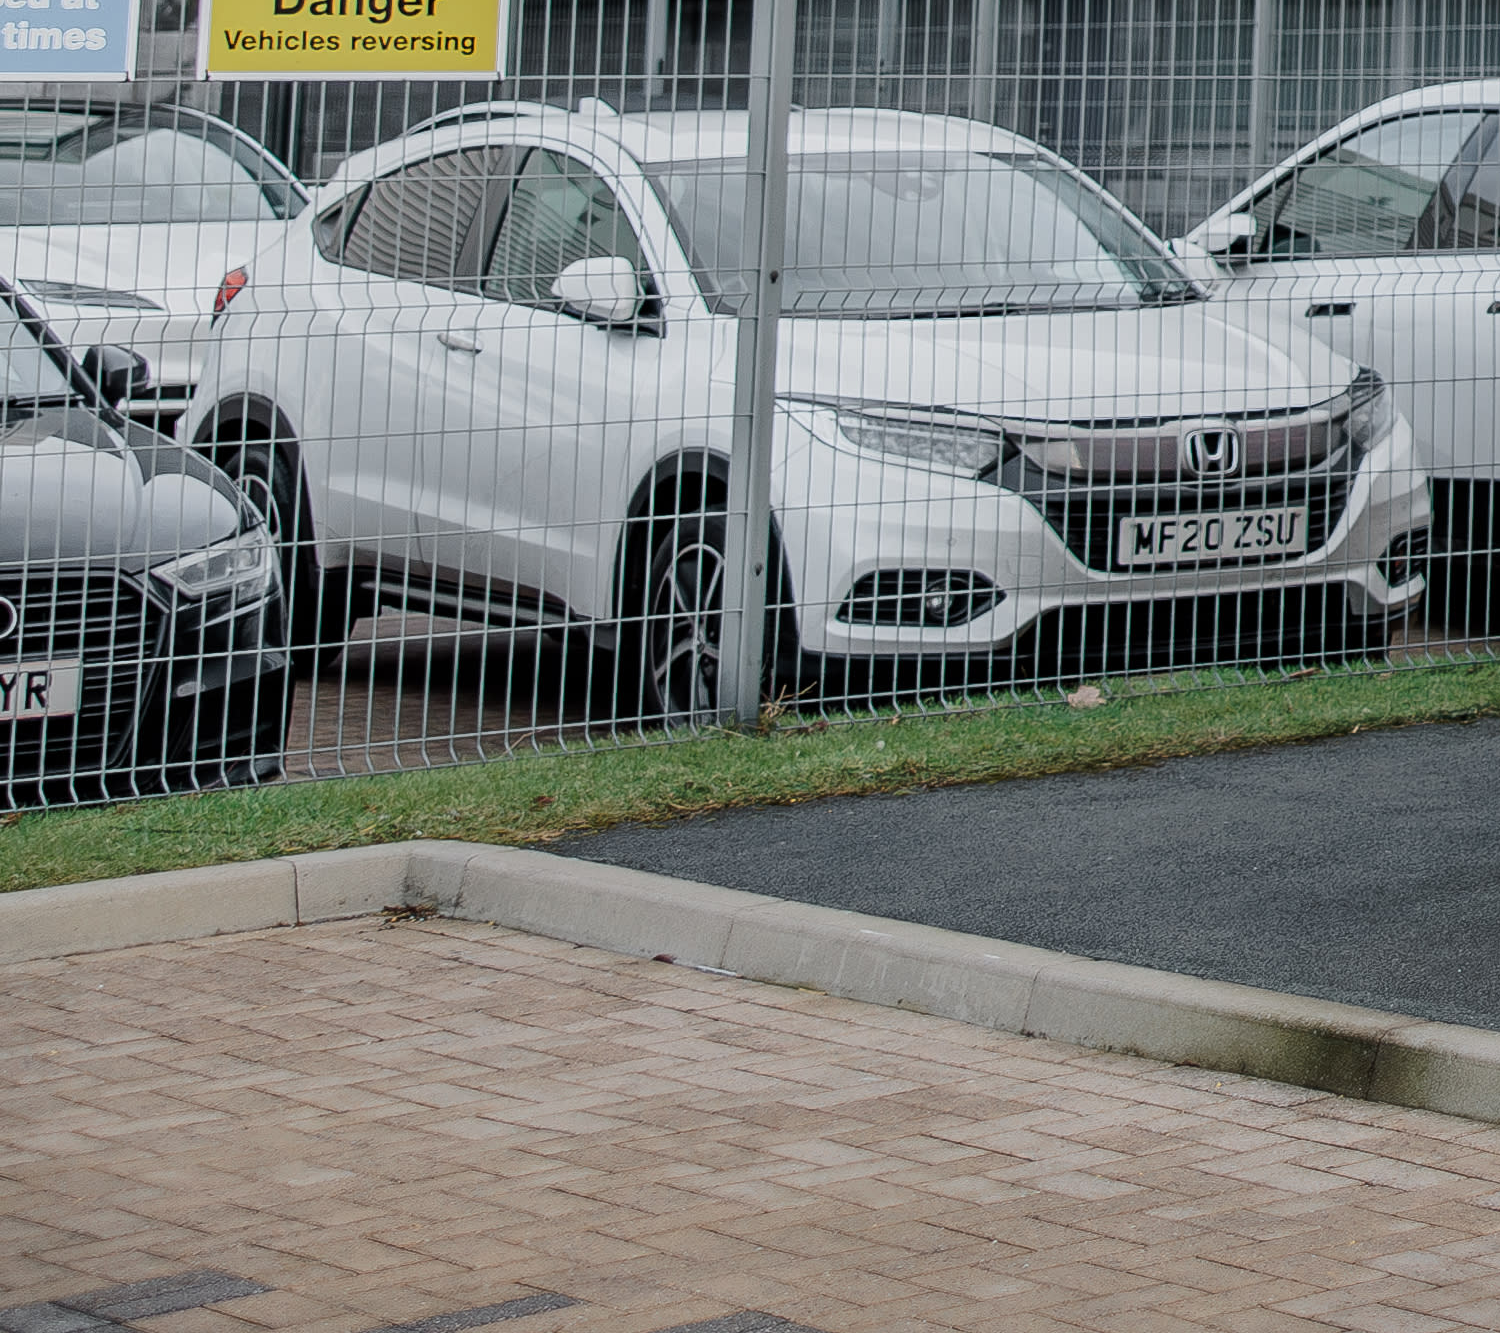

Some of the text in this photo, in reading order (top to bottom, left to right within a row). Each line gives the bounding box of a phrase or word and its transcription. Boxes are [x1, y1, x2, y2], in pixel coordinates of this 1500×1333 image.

[3, 20, 107, 51] times
[224, 30, 477, 56] Vehicles reversing
[1134, 512, 1297, 556] MF20 ZSU
[0, 670, 52, 712] YR
